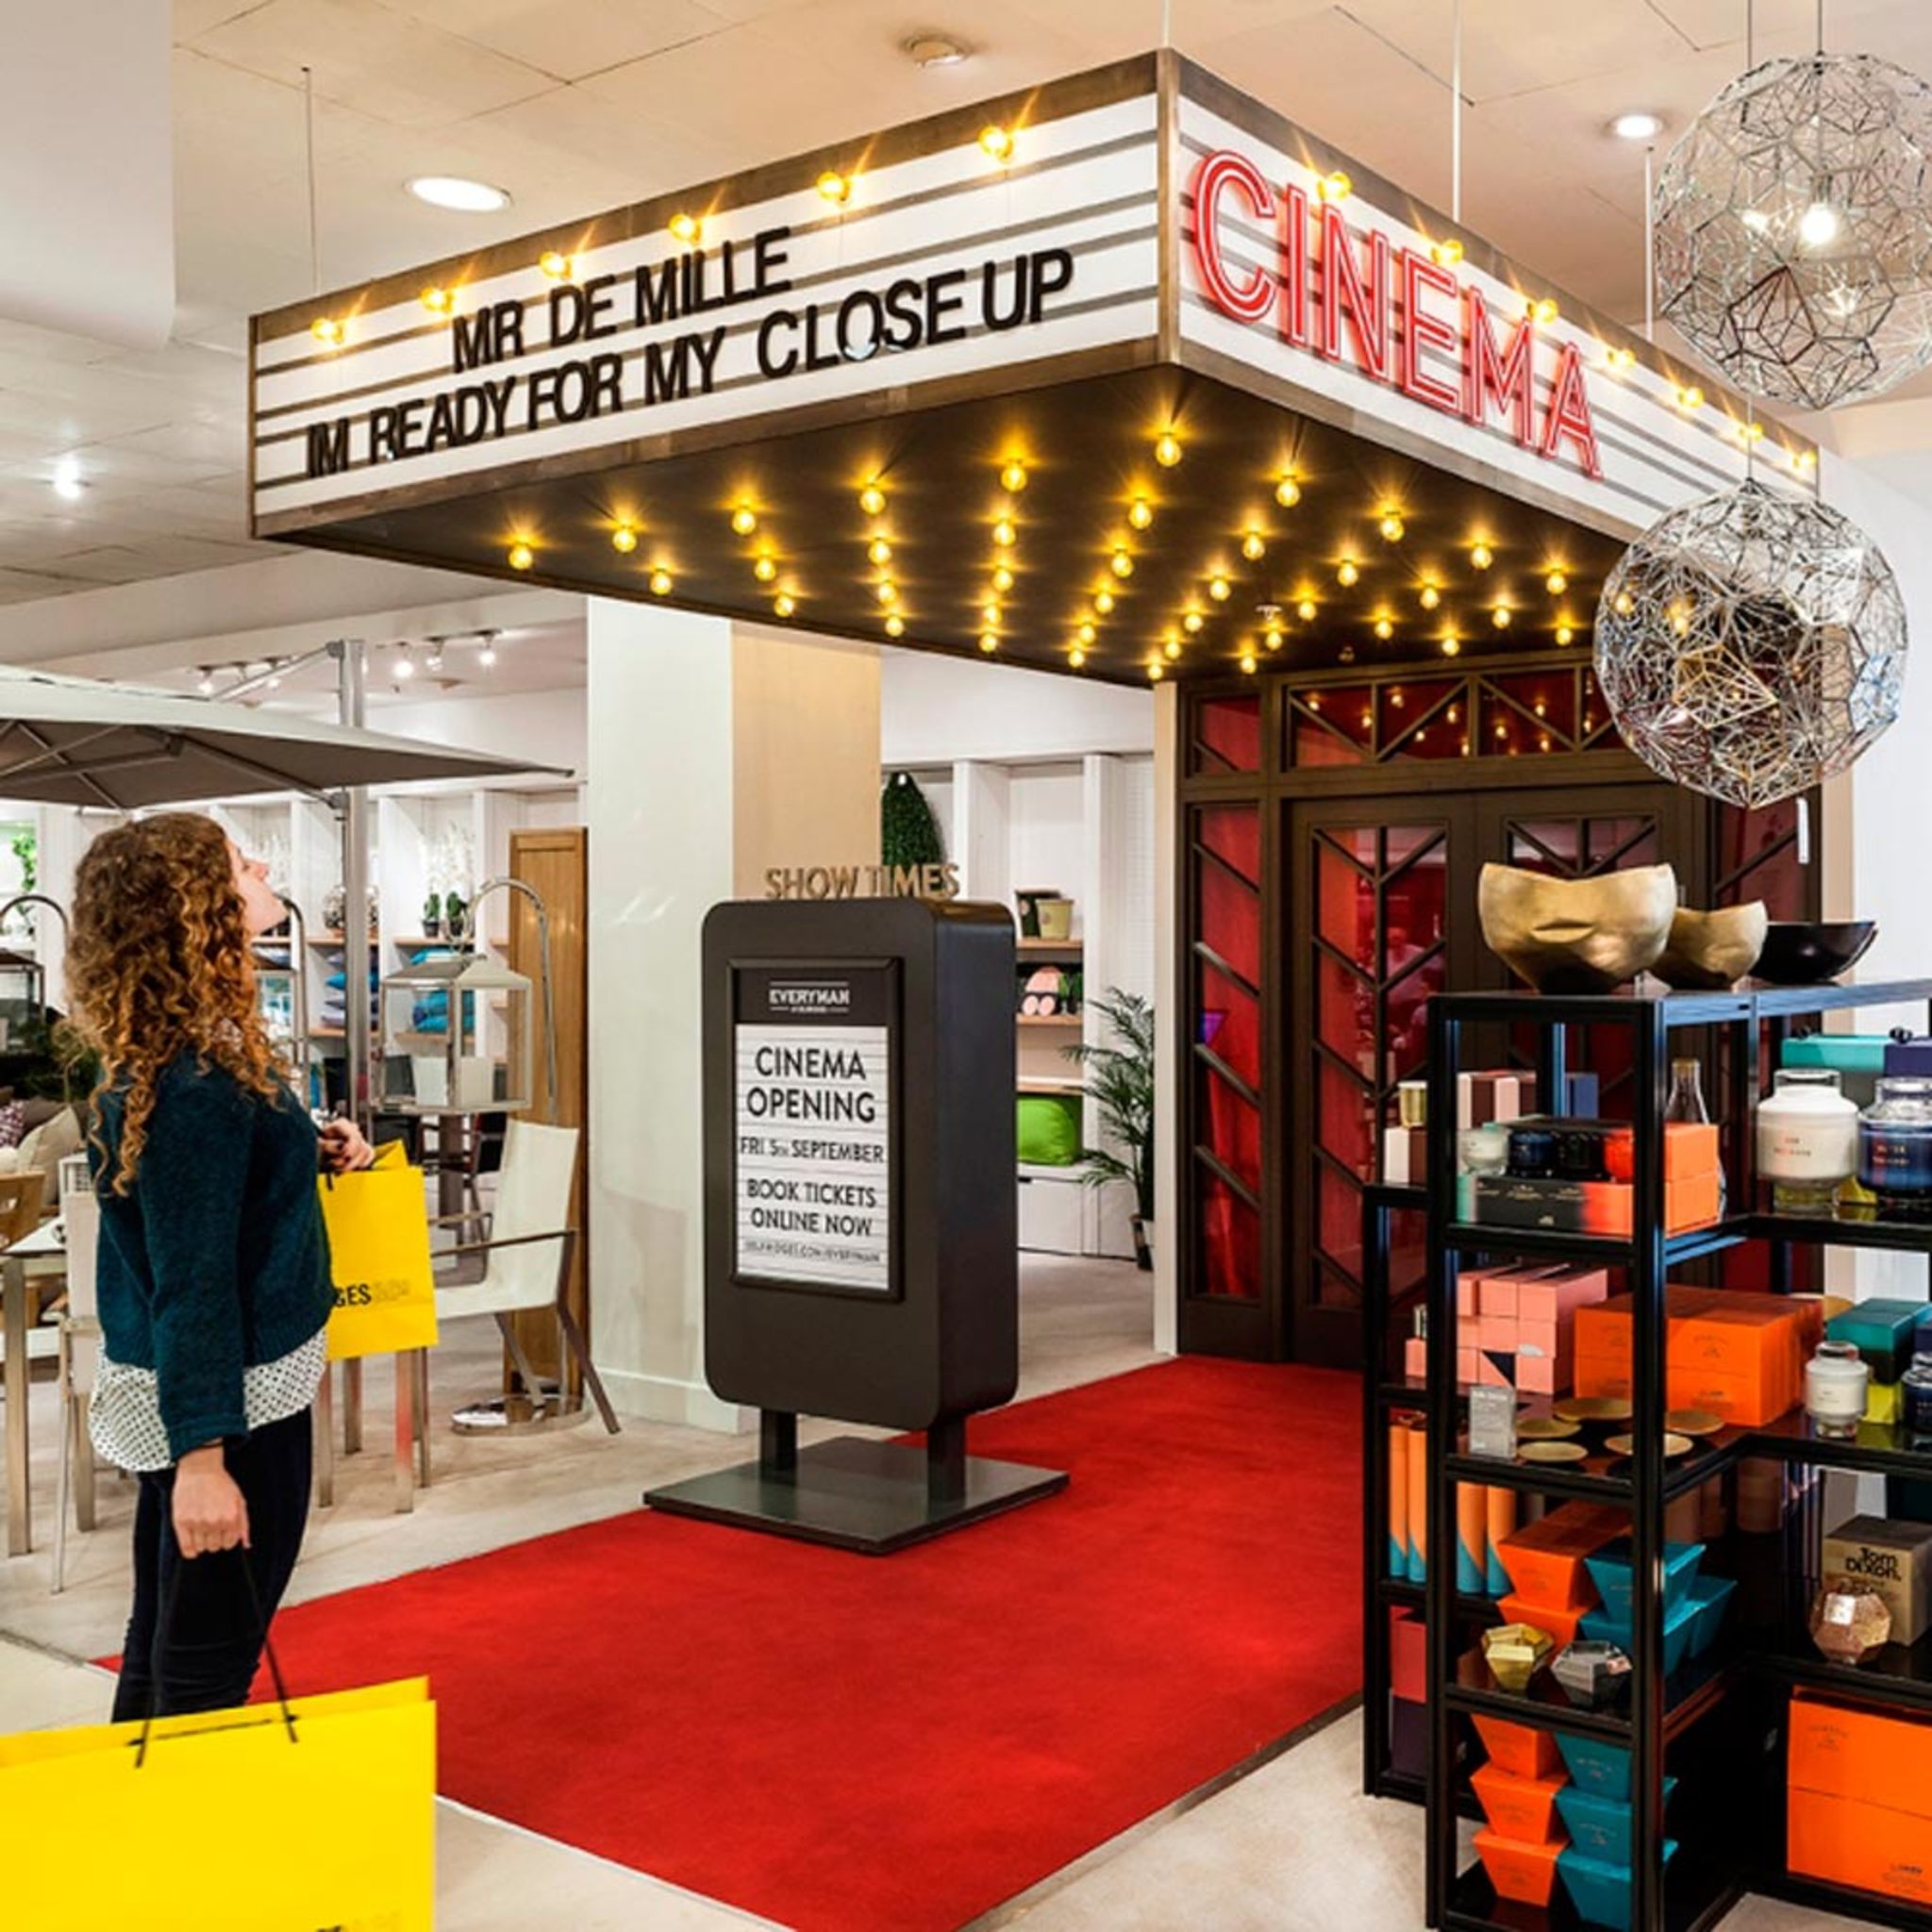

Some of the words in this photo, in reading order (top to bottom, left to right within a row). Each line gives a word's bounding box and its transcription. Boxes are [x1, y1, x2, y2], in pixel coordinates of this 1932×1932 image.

[453, 301, 524, 373] MR
[549, 275, 617, 346] DE
[634, 226, 791, 327] MILLE
[1194, 150, 1604, 481] CINEMA
[307, 418, 349, 478] IM
[370, 377, 516, 464] READY
[527, 353, 624, 430] FOR
[644, 326, 726, 406] MY
[757, 269, 967, 377] CLOSE
[982, 248, 1074, 332] UP
[765, 865, 859, 900] SHOW
[864, 862, 960, 898] TIMES
[769, 989, 850, 1006] EVERYMAN
[755, 1045, 867, 1080] CINEMA
[746, 1086, 876, 1124] OPENING
[740, 1136, 765, 1156] FRI
[791, 1139, 885, 1163] SEPTEMBER
[746, 1178, 800, 1202] BOOK
[804, 1181, 877, 1208] TICKETS
[750, 1207, 821, 1234] ONLINE
[824, 1213, 874, 1238] NOW
[1860, 1546, 1899, 1569] Tom
